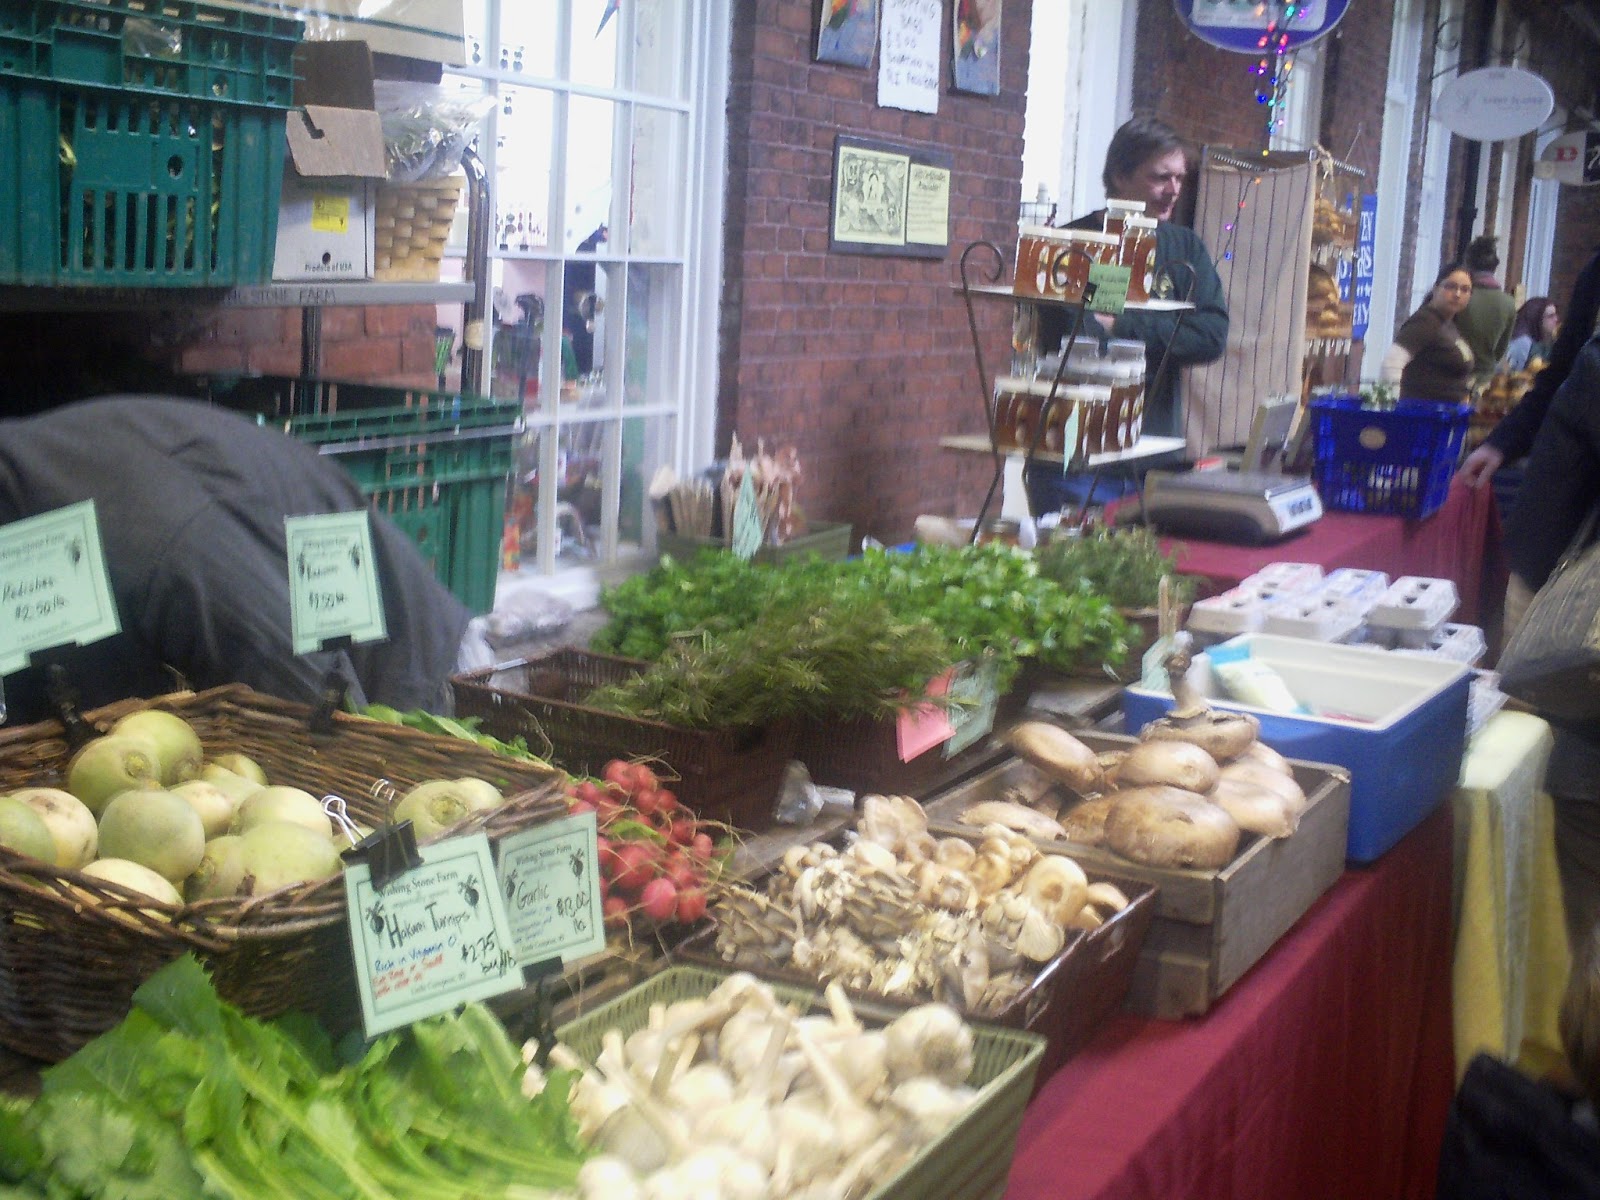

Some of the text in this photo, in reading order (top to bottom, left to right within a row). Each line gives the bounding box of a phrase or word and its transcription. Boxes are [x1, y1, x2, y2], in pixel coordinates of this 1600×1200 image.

[299, 287, 337, 304] FARM
[412, 876, 434, 889] Stone
[436, 871, 458, 883] Farm
[516, 880, 550, 911] Garlic
[424, 900, 470, 935] Turnips
